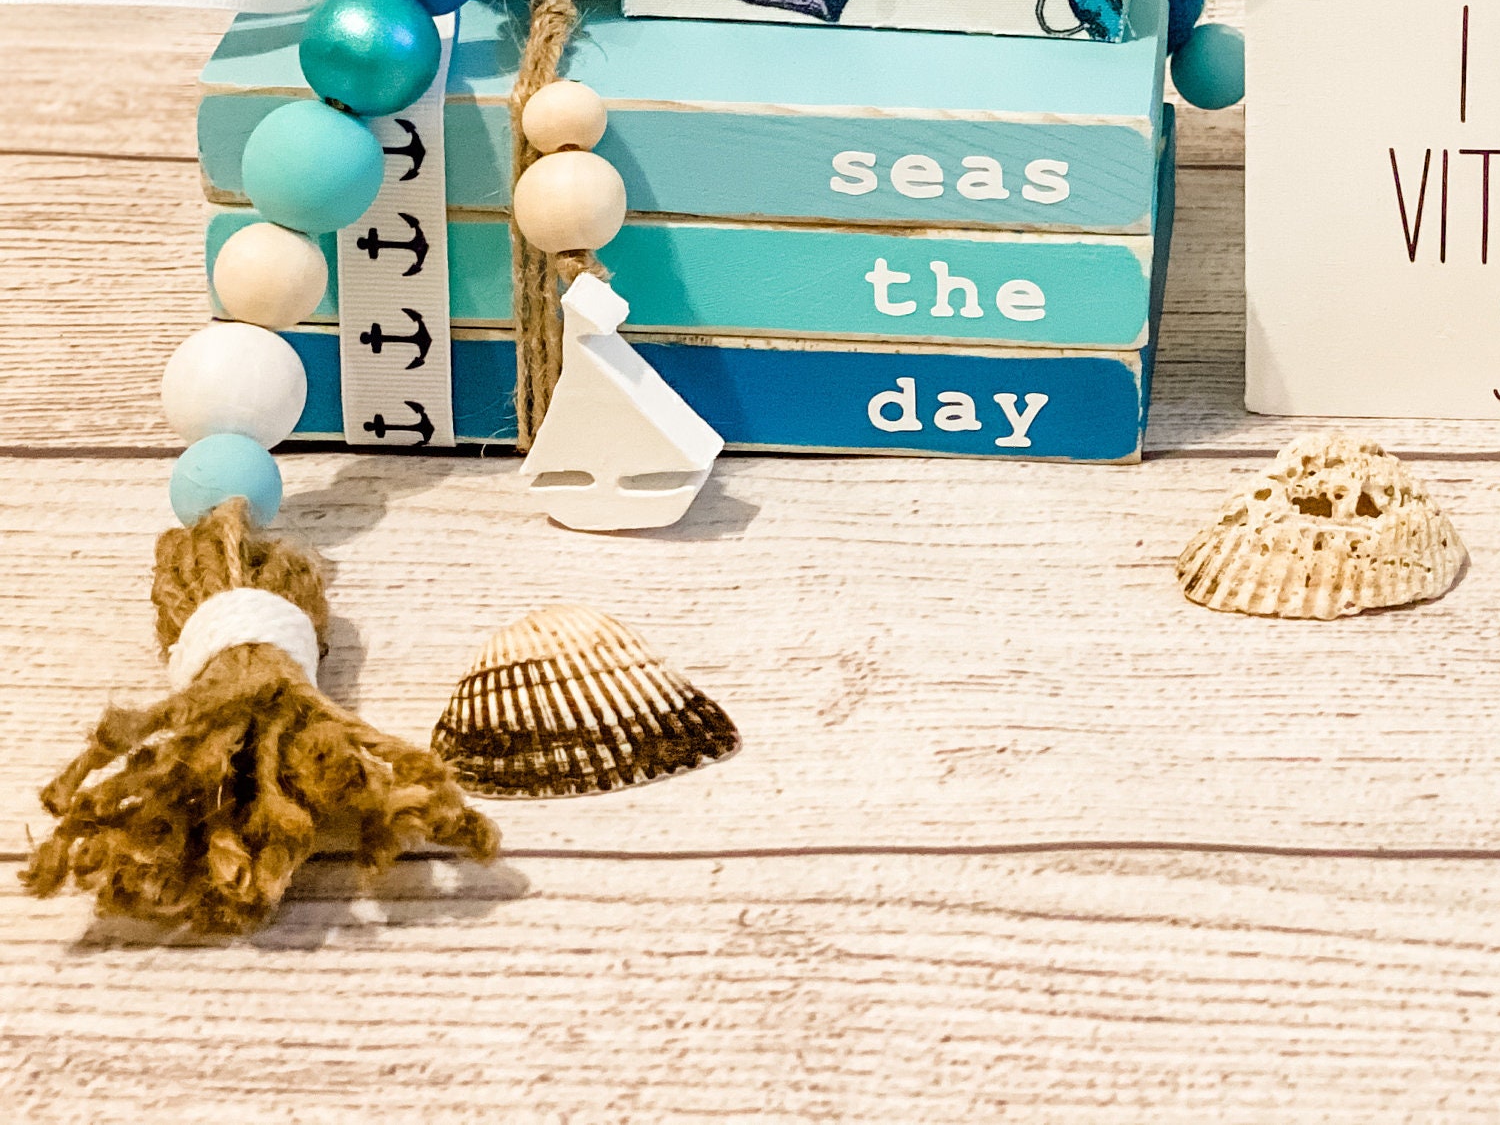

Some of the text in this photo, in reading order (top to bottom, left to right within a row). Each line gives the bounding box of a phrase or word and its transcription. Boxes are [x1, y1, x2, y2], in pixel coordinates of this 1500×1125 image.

[1459, 4, 1470, 124] I
[829, 150, 1071, 205] seas
[864, 257, 1047, 322] the
[867, 376, 1050, 449] day
